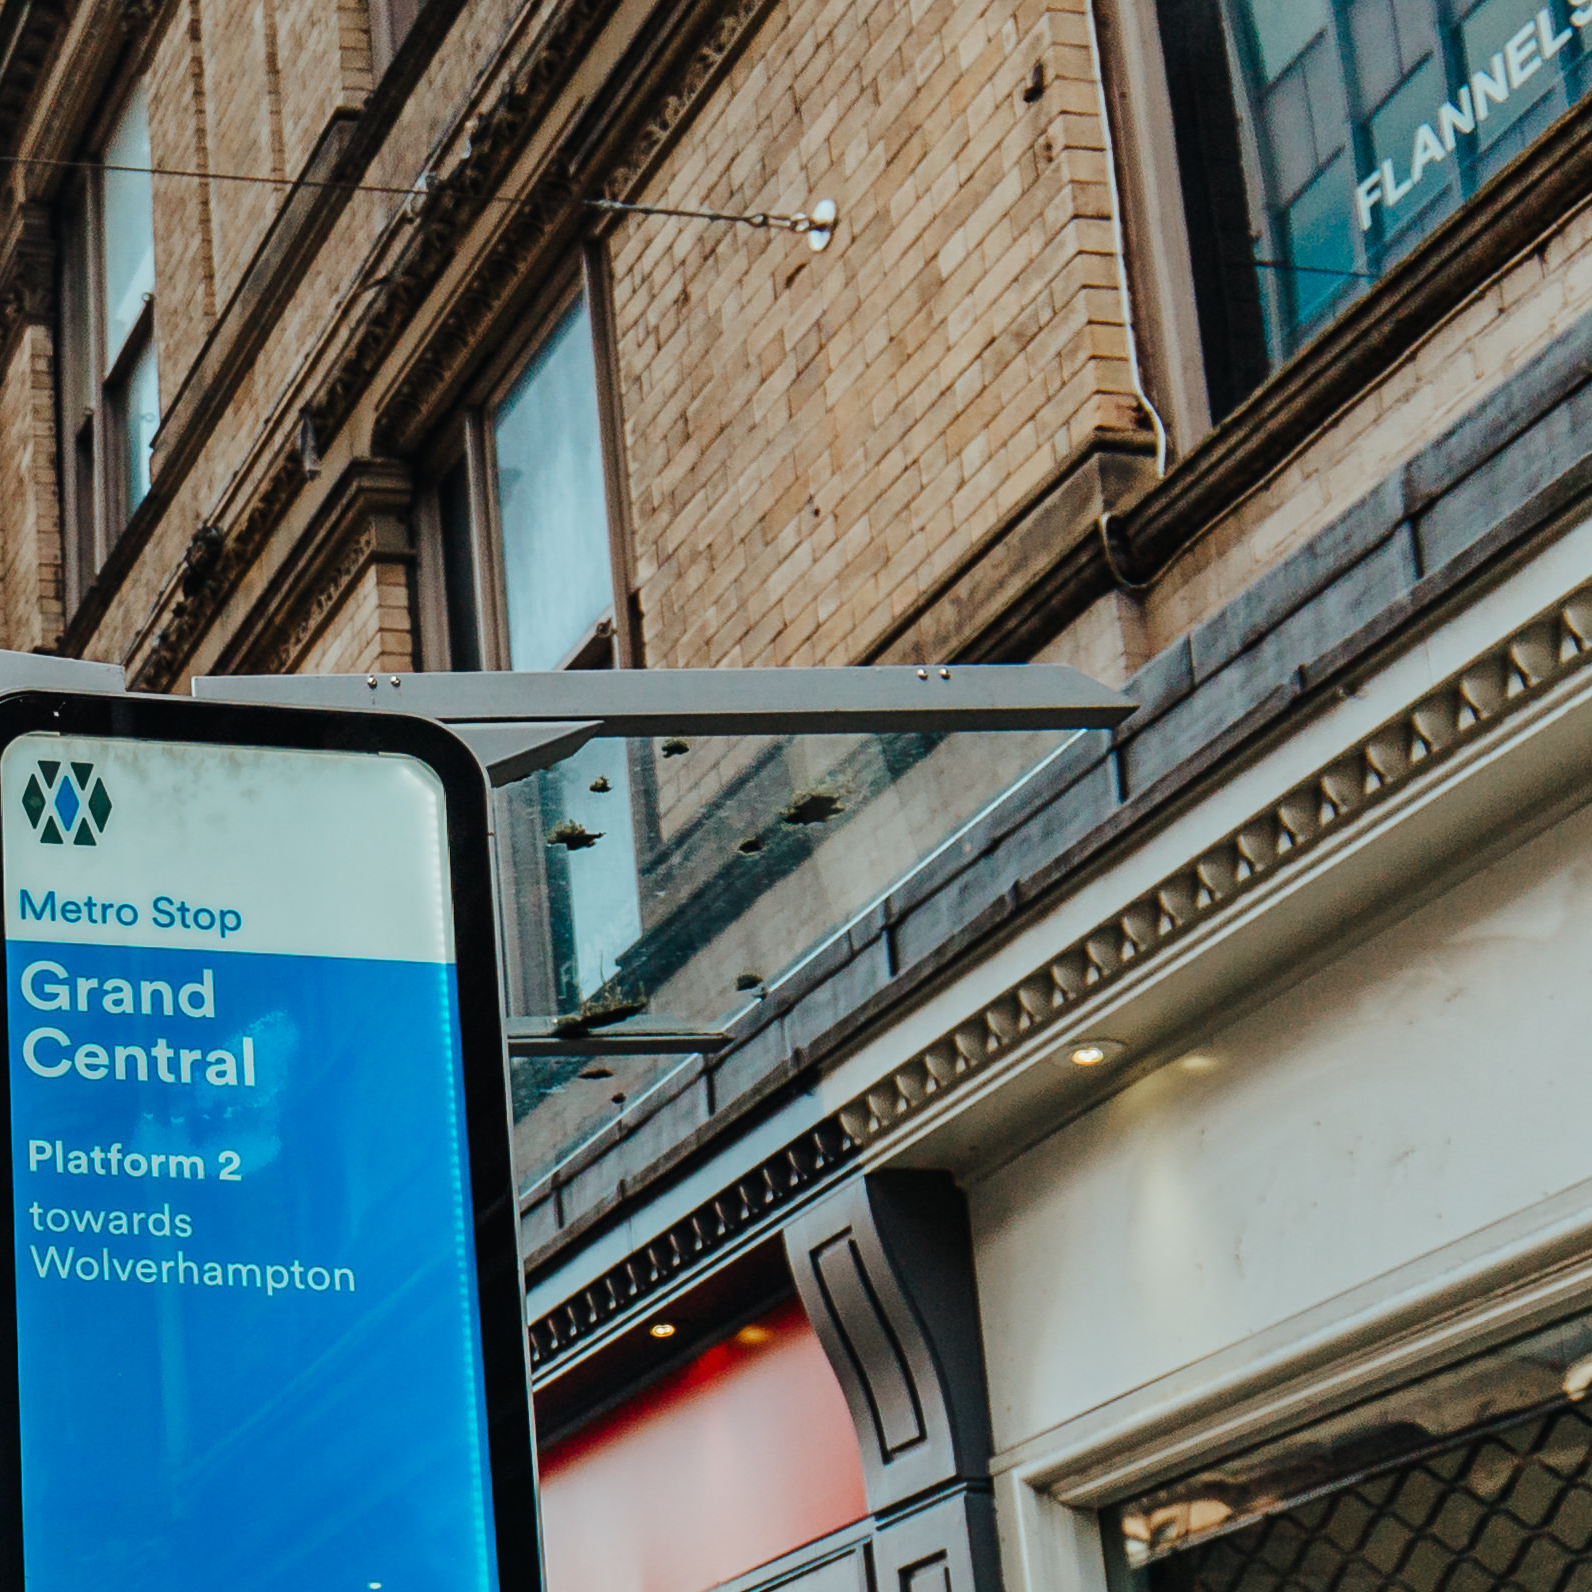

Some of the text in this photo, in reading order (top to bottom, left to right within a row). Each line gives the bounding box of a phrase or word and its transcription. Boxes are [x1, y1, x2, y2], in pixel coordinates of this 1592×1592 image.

[19, 889, 242, 937] Metro Stop
[20, 960, 216, 1018] Grand
[21, 1028, 255, 1086] Central
[28, 1140, 242, 1181] Platform 2
[29, 1202, 193, 1238] towards
[29, 1246, 356, 1296] Wolverhampton
